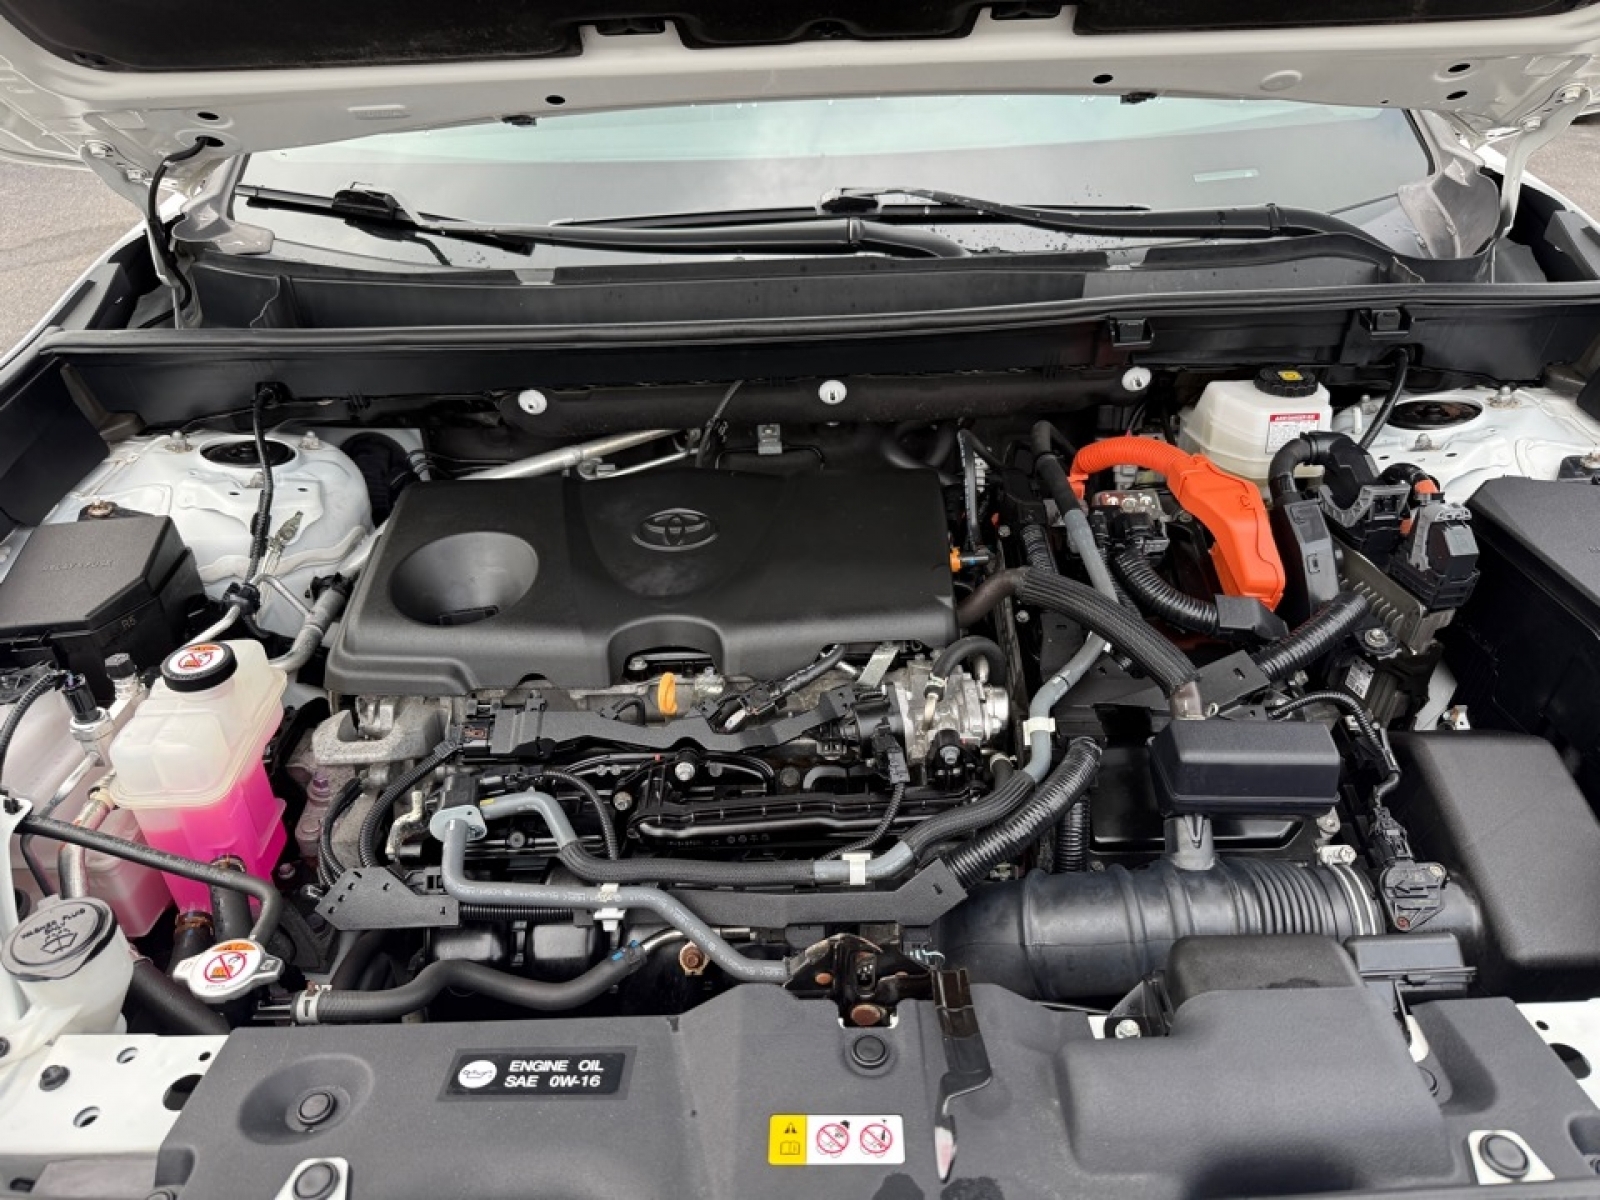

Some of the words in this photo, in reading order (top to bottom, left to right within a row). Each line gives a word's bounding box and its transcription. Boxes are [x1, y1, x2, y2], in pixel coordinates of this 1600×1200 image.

[509, 1059, 570, 1072] ENGINE
[578, 1059, 604, 1072] OIL
[504, 1075, 540, 1088] SAE
[550, 1075, 601, 1088] 0W-16
